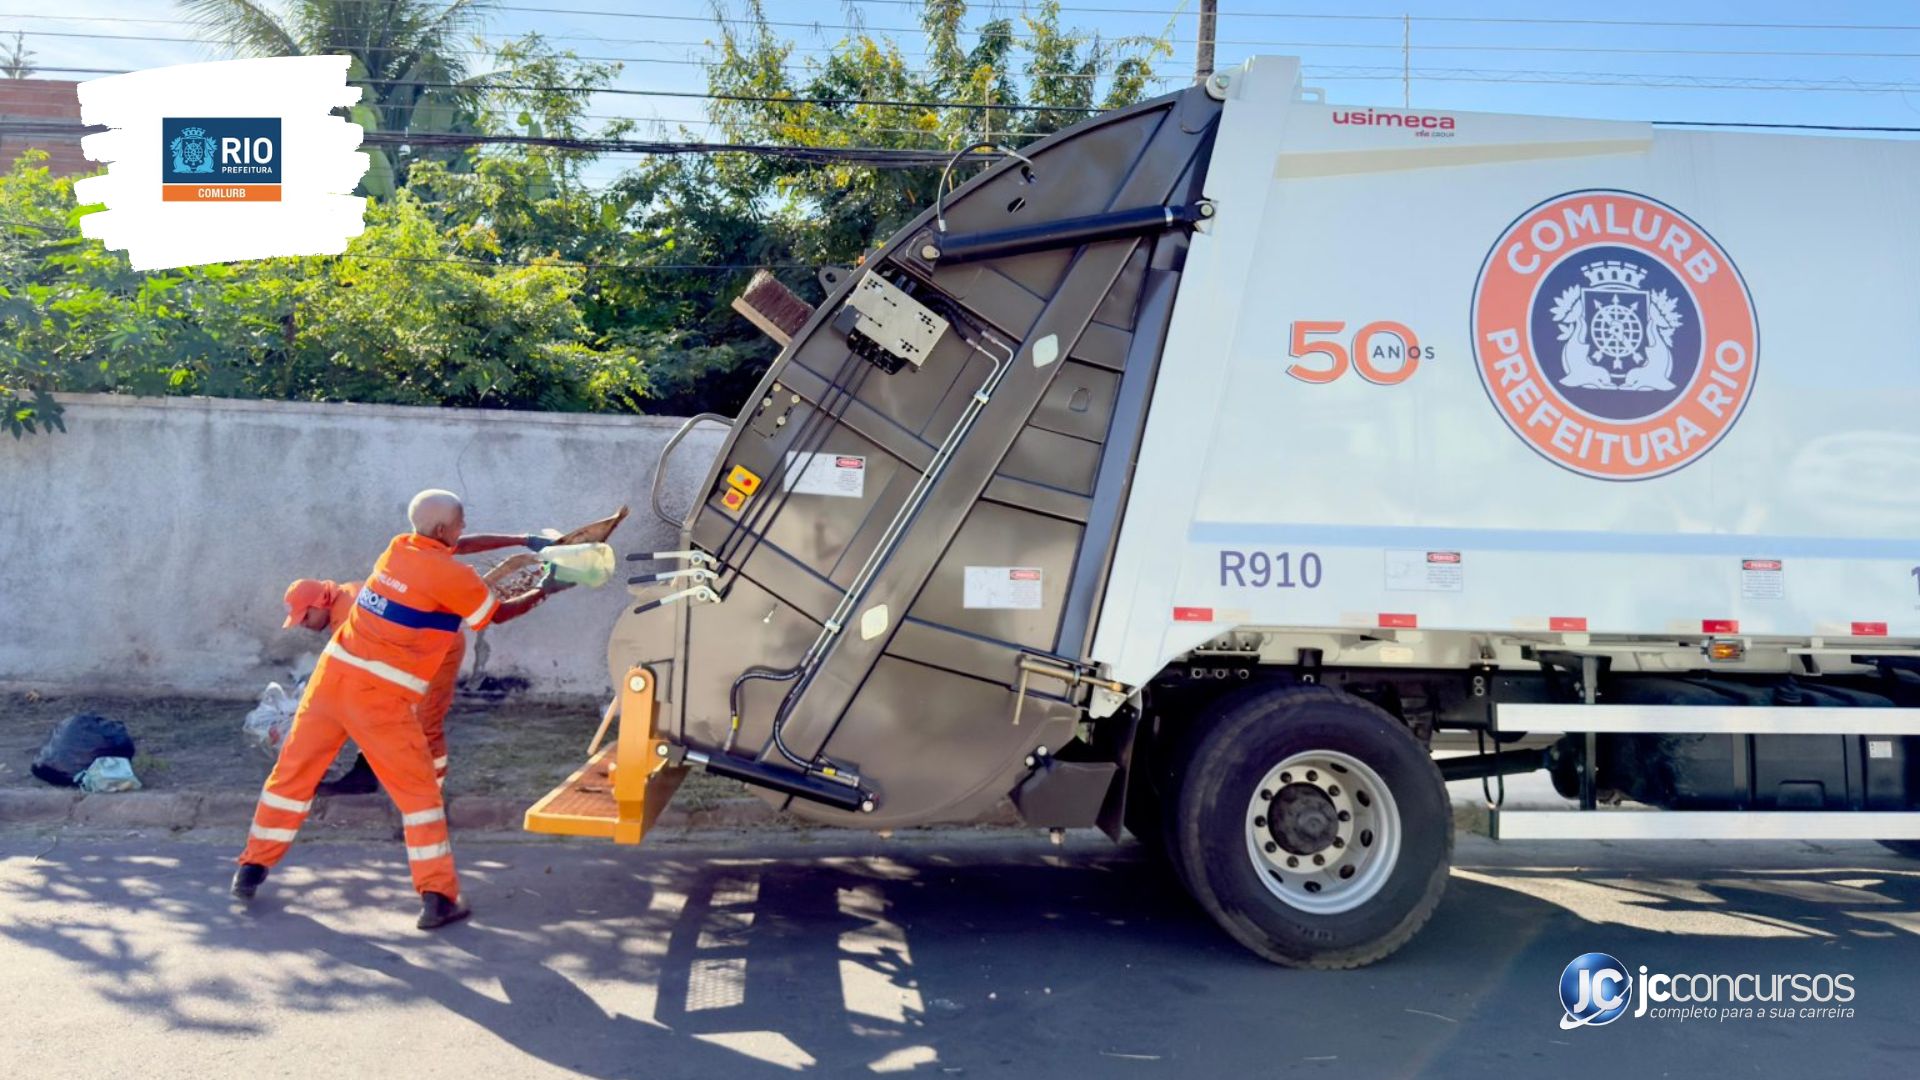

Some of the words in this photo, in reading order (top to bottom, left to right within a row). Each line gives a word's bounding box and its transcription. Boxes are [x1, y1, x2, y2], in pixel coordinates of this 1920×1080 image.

[1332, 108, 1455, 129] usimeca
[1506, 203, 1718, 284] COMLURB
[1284, 320, 1420, 386] 50
[1372, 345, 1435, 360] ANOS
[1486, 327, 1707, 467] PREFEITURA
[1697, 339, 1746, 418] RIO
[1219, 550, 1322, 588] R910
